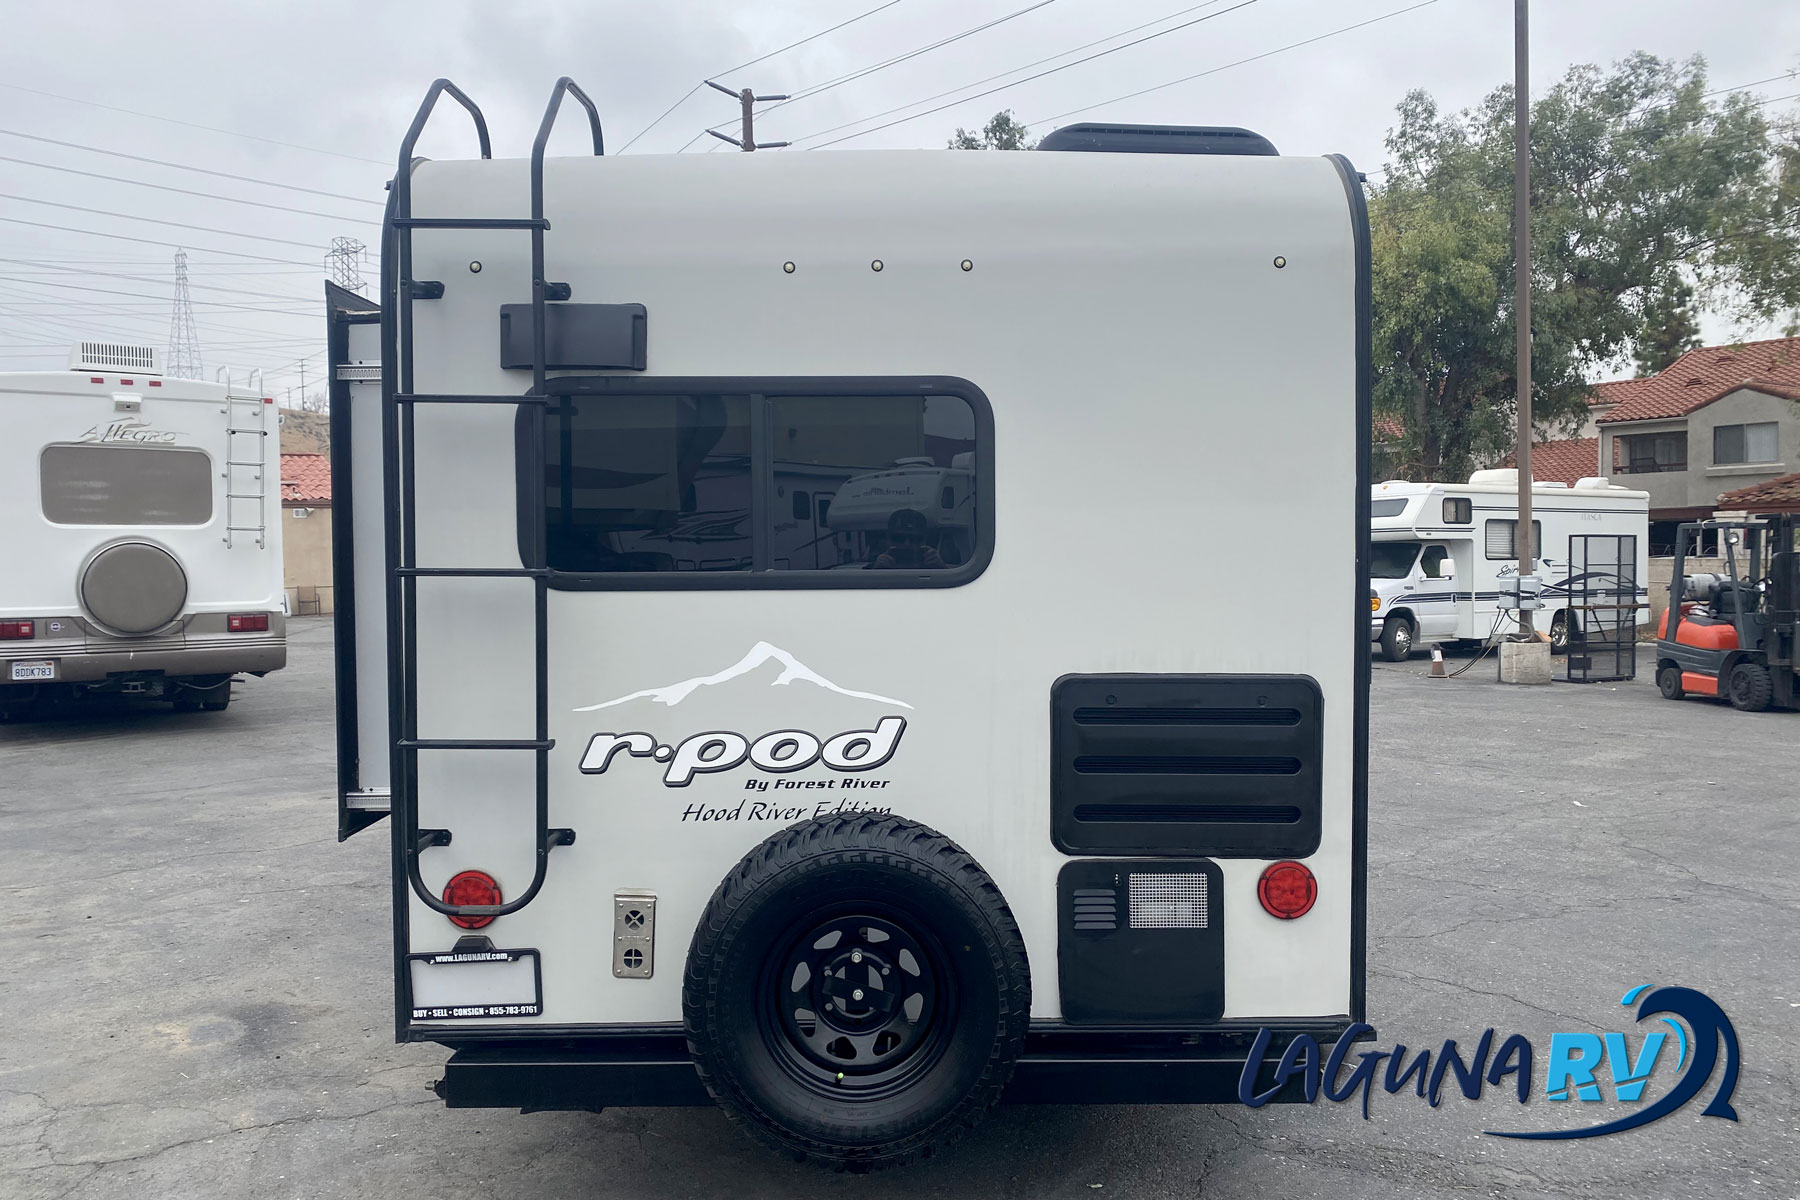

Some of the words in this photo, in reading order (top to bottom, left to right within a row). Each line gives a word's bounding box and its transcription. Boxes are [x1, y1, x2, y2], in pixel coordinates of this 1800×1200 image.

[15, 667, 52, 677] 8DDK783
[744, 778, 769, 792] By
[773, 778, 836, 790] Forest
[840, 778, 891, 790] River
[681, 799, 747, 822] Hood
[747, 801, 808, 822] River
[413, 1009, 428, 1018] BUY
[432, 1008, 449, 1017] SELL
[453, 1007, 485, 1017] CONSIGN
[489, 1005, 538, 1015] 855-783-9761
